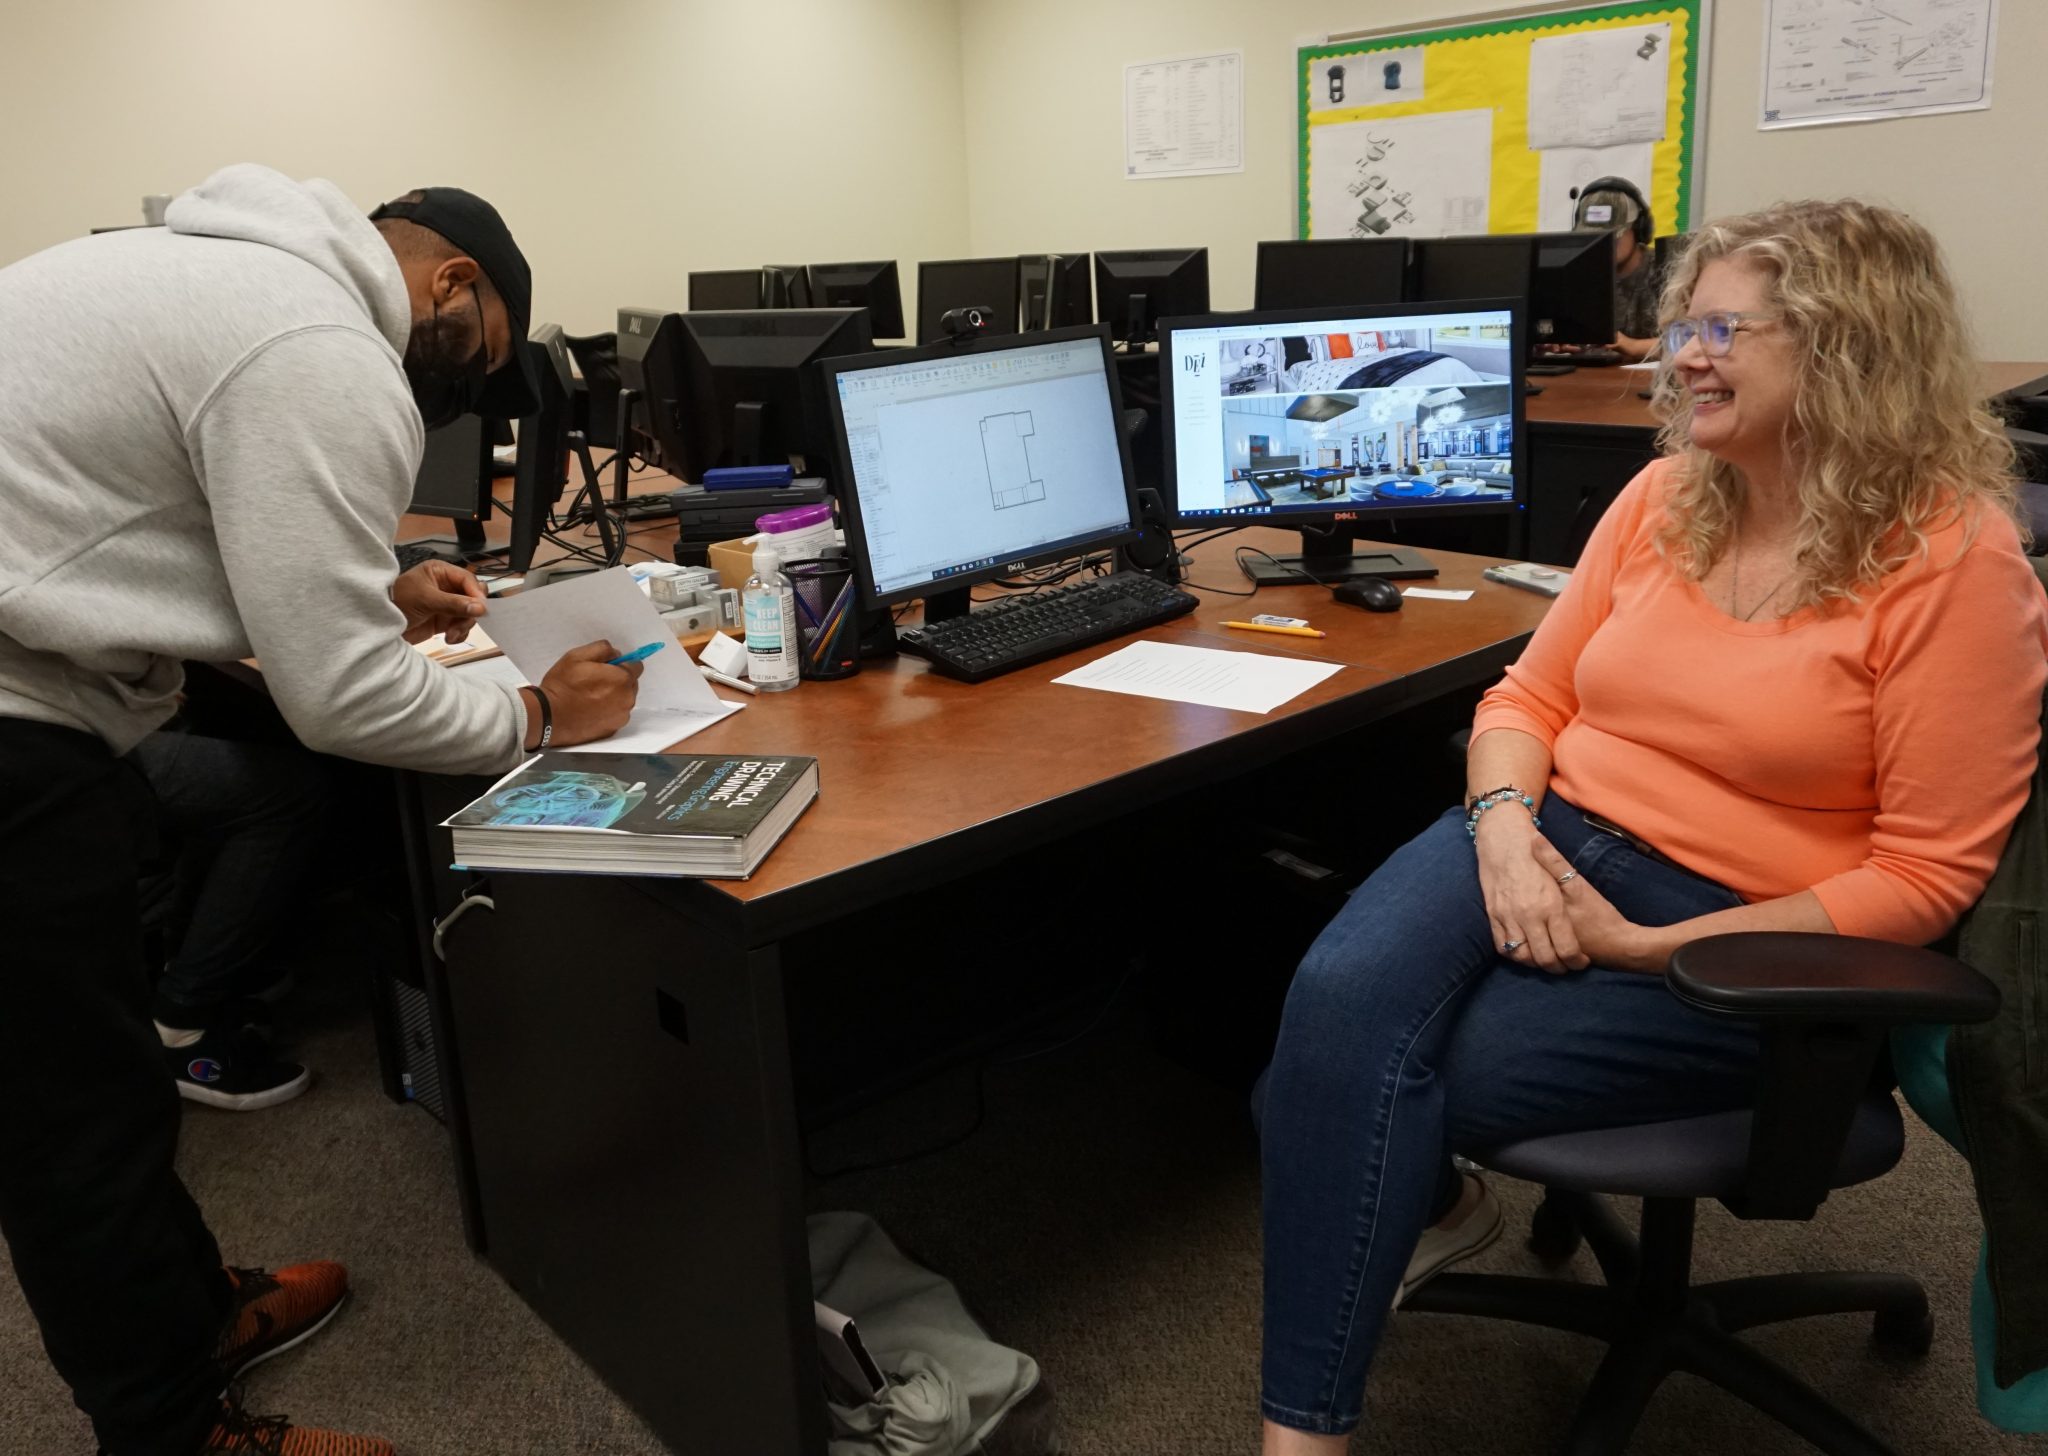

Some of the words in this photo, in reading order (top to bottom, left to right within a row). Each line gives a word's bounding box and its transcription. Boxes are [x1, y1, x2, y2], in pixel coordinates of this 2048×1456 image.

[1334, 512, 1358, 520] DELL
[1008, 562, 1026, 572] DELL
[757, 608, 778, 619] KEEP
[692, 761, 739, 797] Engineering
[708, 761, 762, 801] DRAWING
[727, 762, 786, 808] TECHNICAL
[667, 793, 705, 820] Graphics
